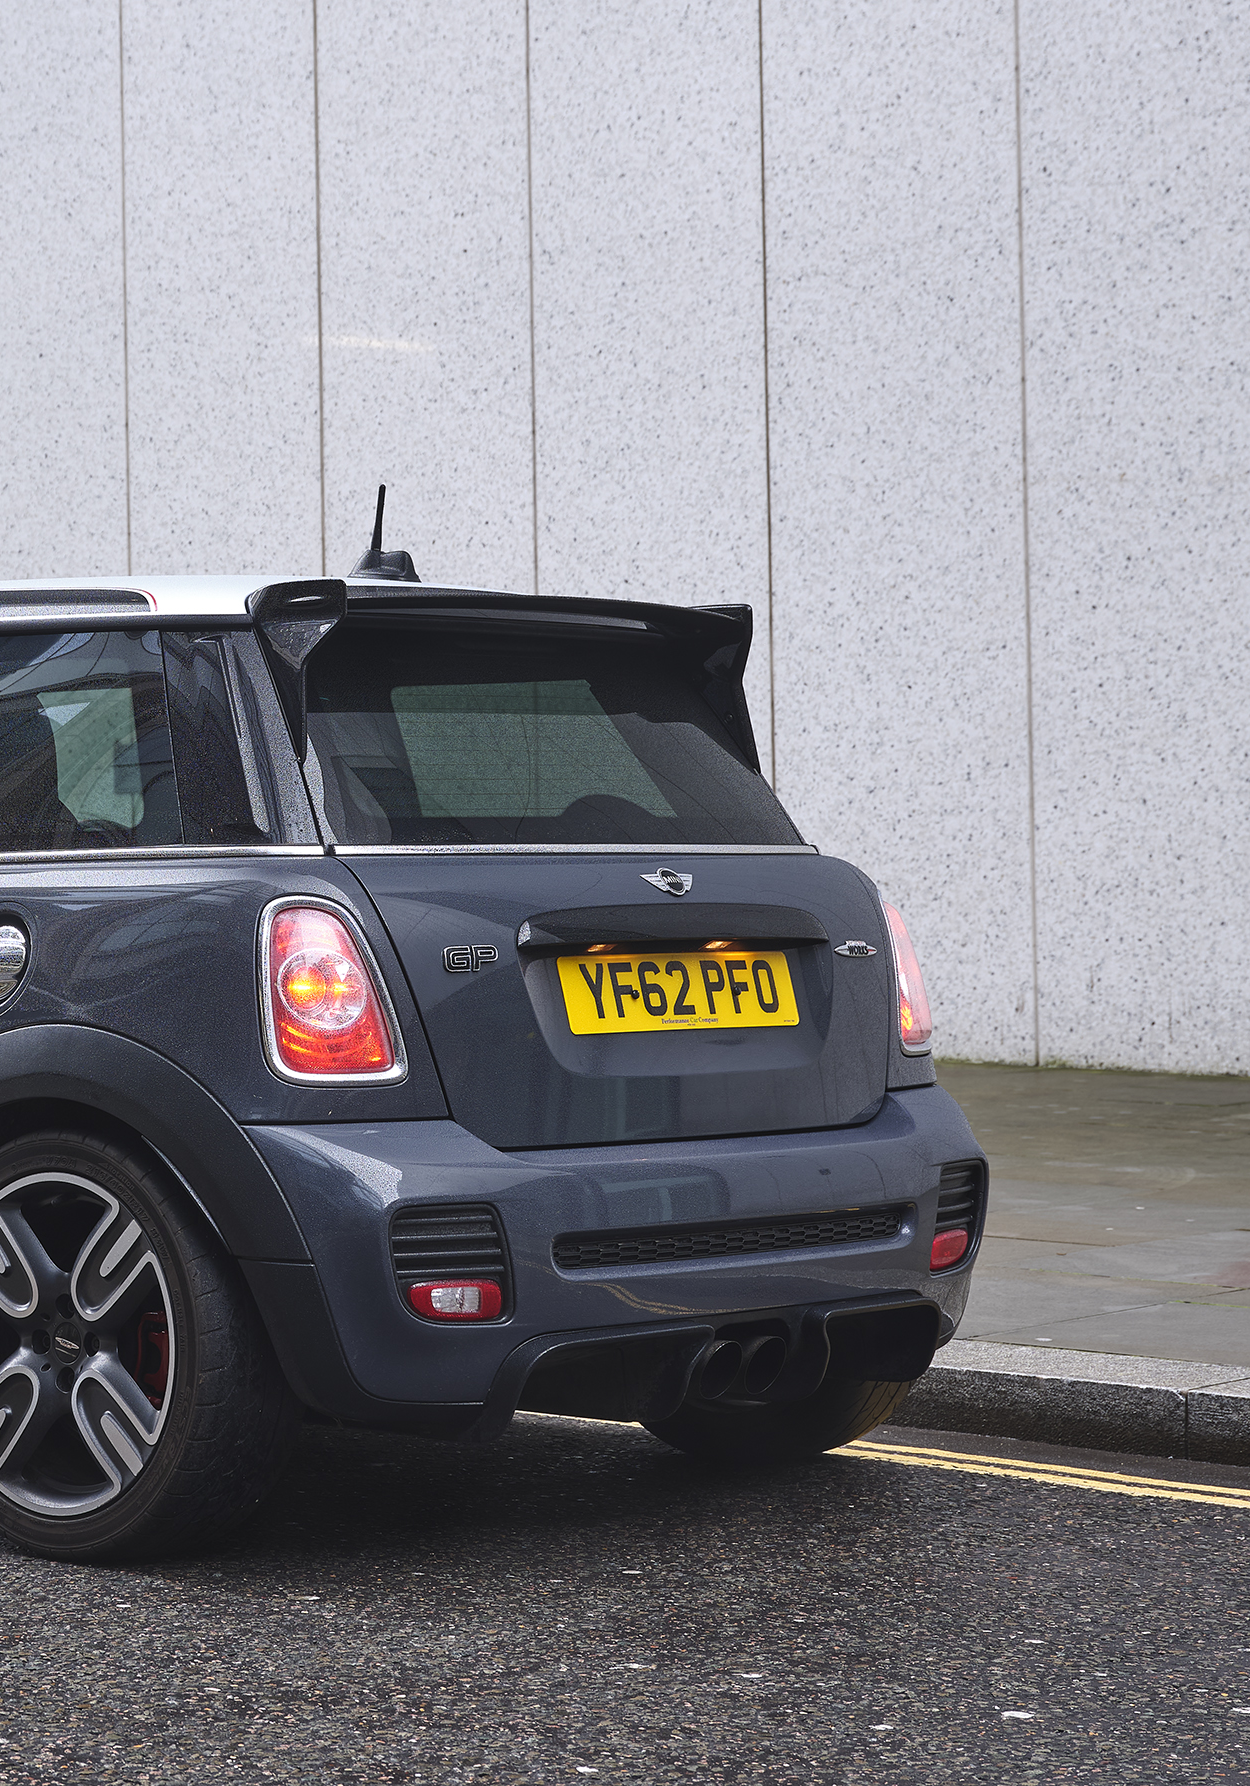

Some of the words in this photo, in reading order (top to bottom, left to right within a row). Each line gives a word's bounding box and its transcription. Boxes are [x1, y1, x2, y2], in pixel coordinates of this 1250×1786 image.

[443, 944, 499, 972] GP
[578, 961, 698, 1019] YF62
[699, 960, 780, 1014] PFO
[108, 1164, 135, 1191] Rotation
